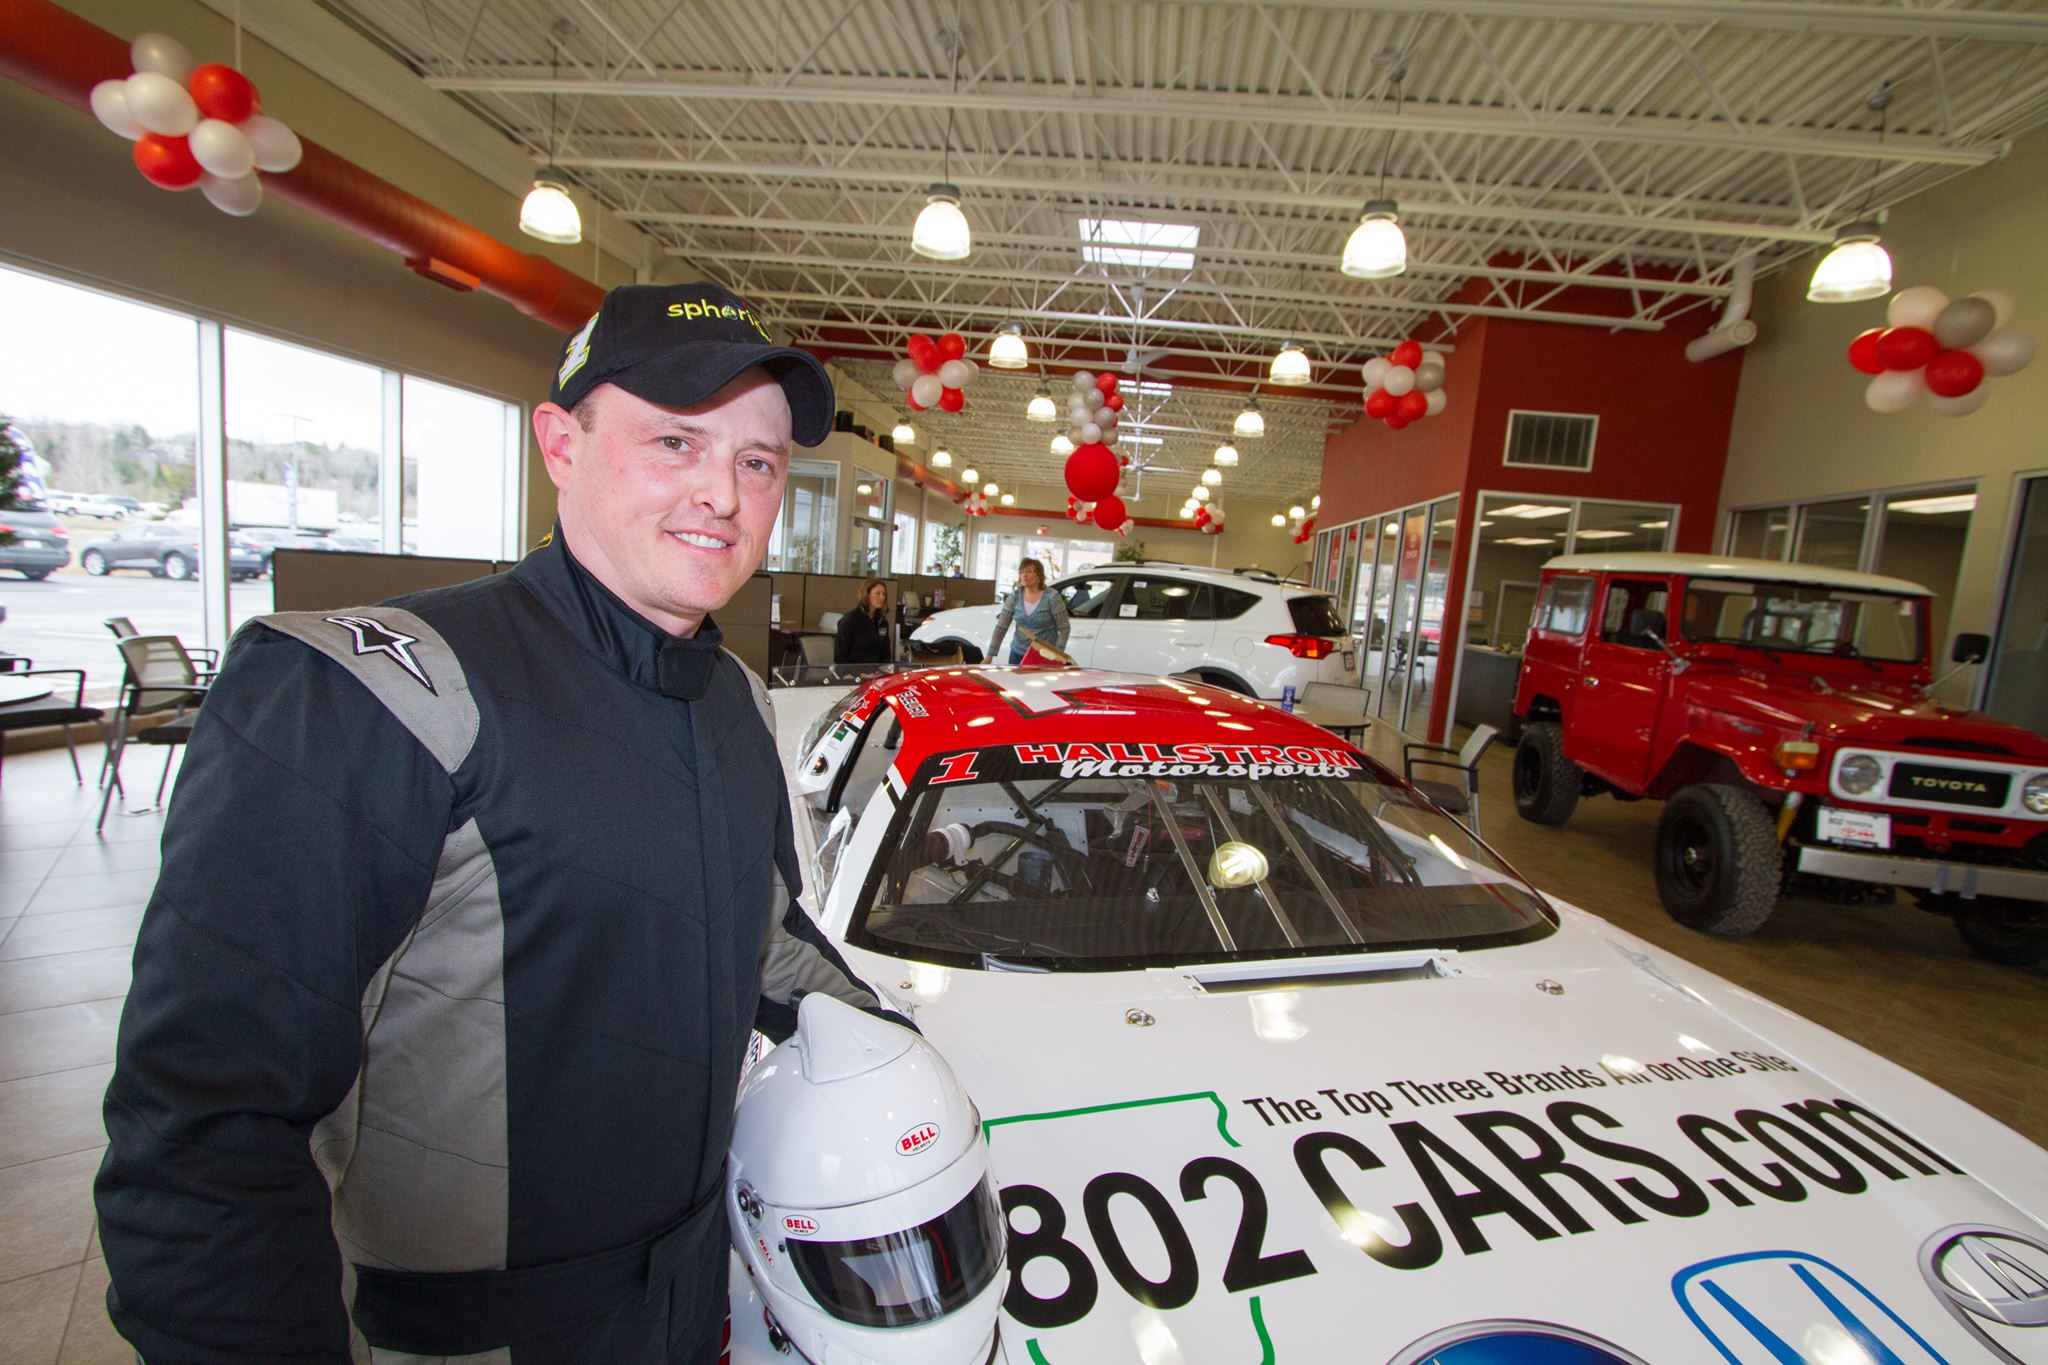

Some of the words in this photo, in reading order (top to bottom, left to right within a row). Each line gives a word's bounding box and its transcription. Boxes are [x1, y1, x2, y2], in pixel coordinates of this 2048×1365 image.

[928, 752, 980, 785] 1
[1013, 743, 1362, 769] HALLSTROM
[1060, 757, 1351, 781] Motorsports
[1911, 776, 1987, 793] TOYOTA
[1242, 1097, 1322, 1127] The
[1317, 1089, 1394, 1118] Top
[1385, 1079, 1494, 1107] Three
[1484, 1065, 1606, 1095] Brands
[1645, 1063, 1693, 1082] on
[1676, 1056, 1747, 1079] One
[1730, 1051, 1799, 1073] Site
[900, 1127, 936, 1151] BELL
[786, 1218, 815, 1230] BELL
[999, 1156, 1319, 1329] 802
[1293, 1096, 1968, 1271] CARS.com
